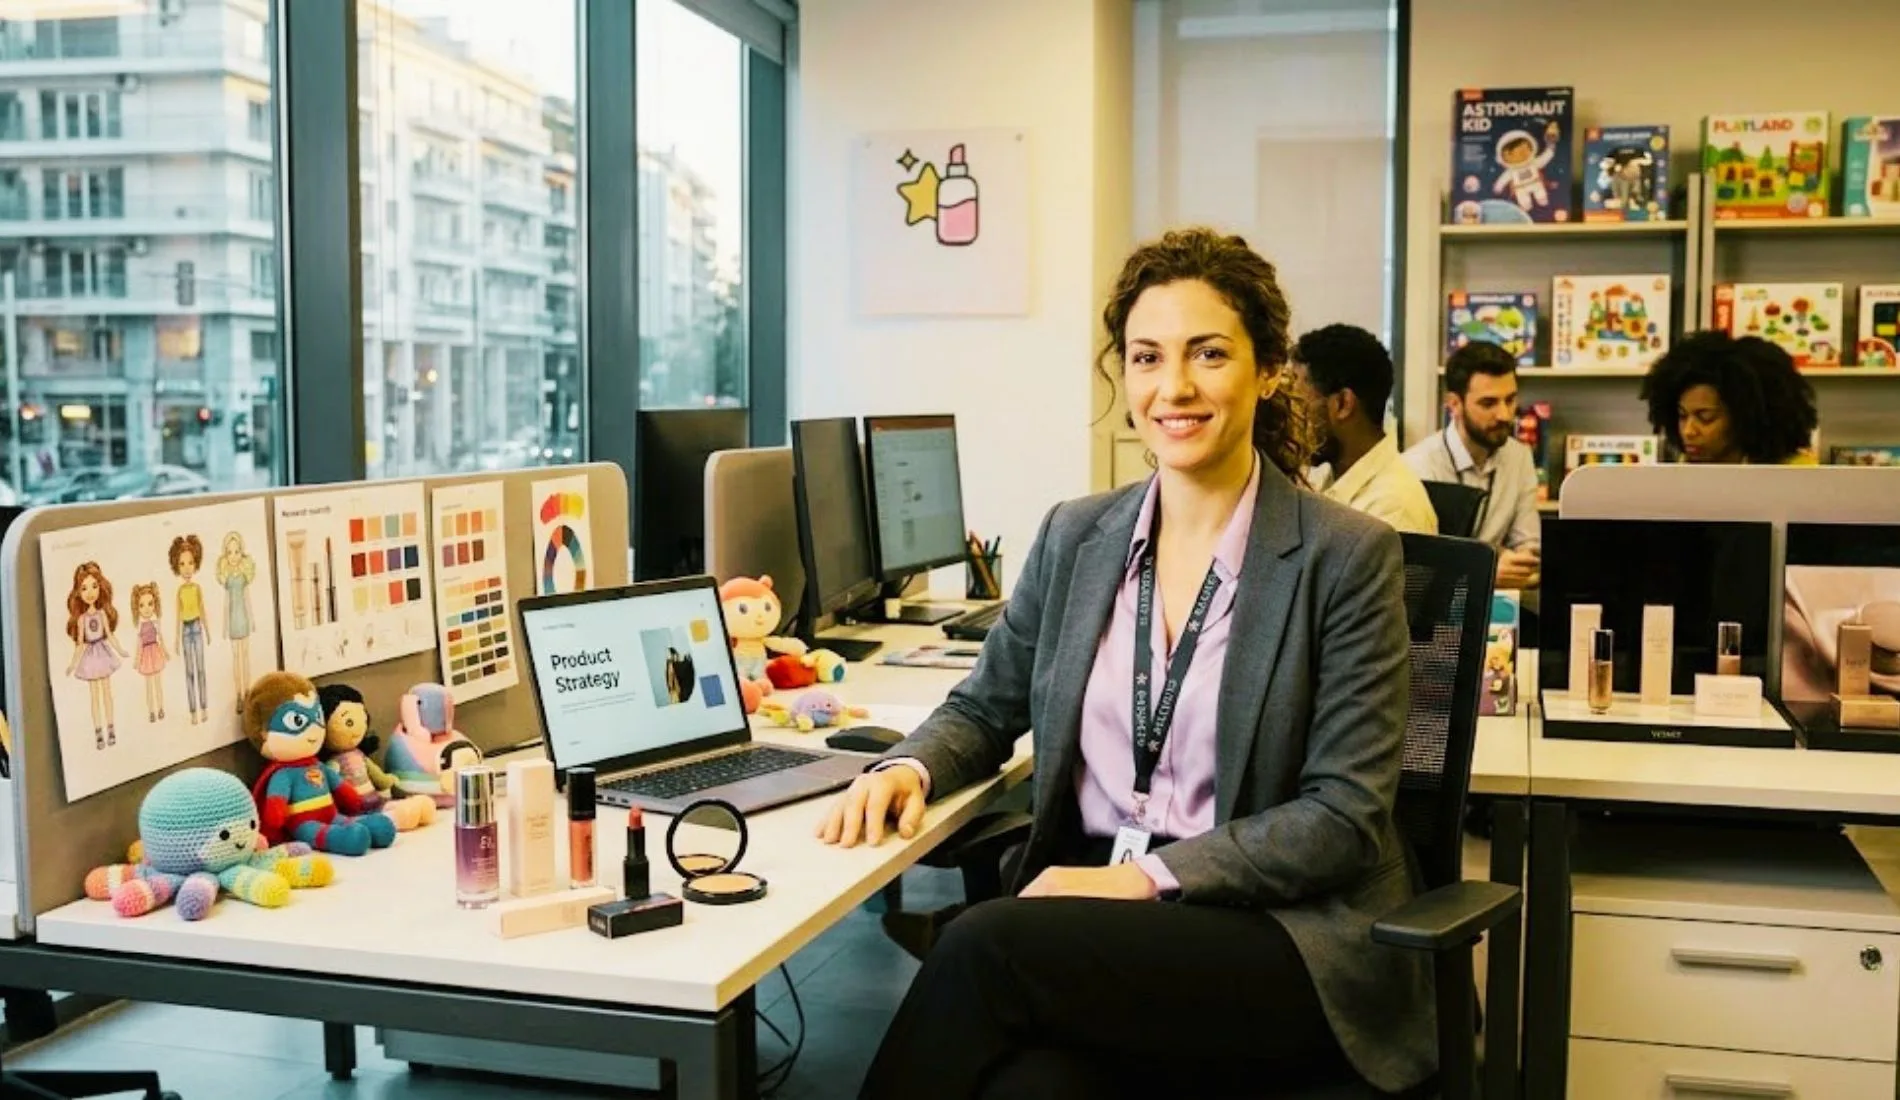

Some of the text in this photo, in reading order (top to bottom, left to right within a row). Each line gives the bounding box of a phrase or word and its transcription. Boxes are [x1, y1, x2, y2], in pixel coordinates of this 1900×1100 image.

[1463, 100, 1565, 117] ASTRONAUT
[1462, 117, 1492, 132] KID
[1713, 118, 1794, 133] PLAYLAND
[550, 648, 612, 670] Product
[556, 669, 620, 693] Strategy
